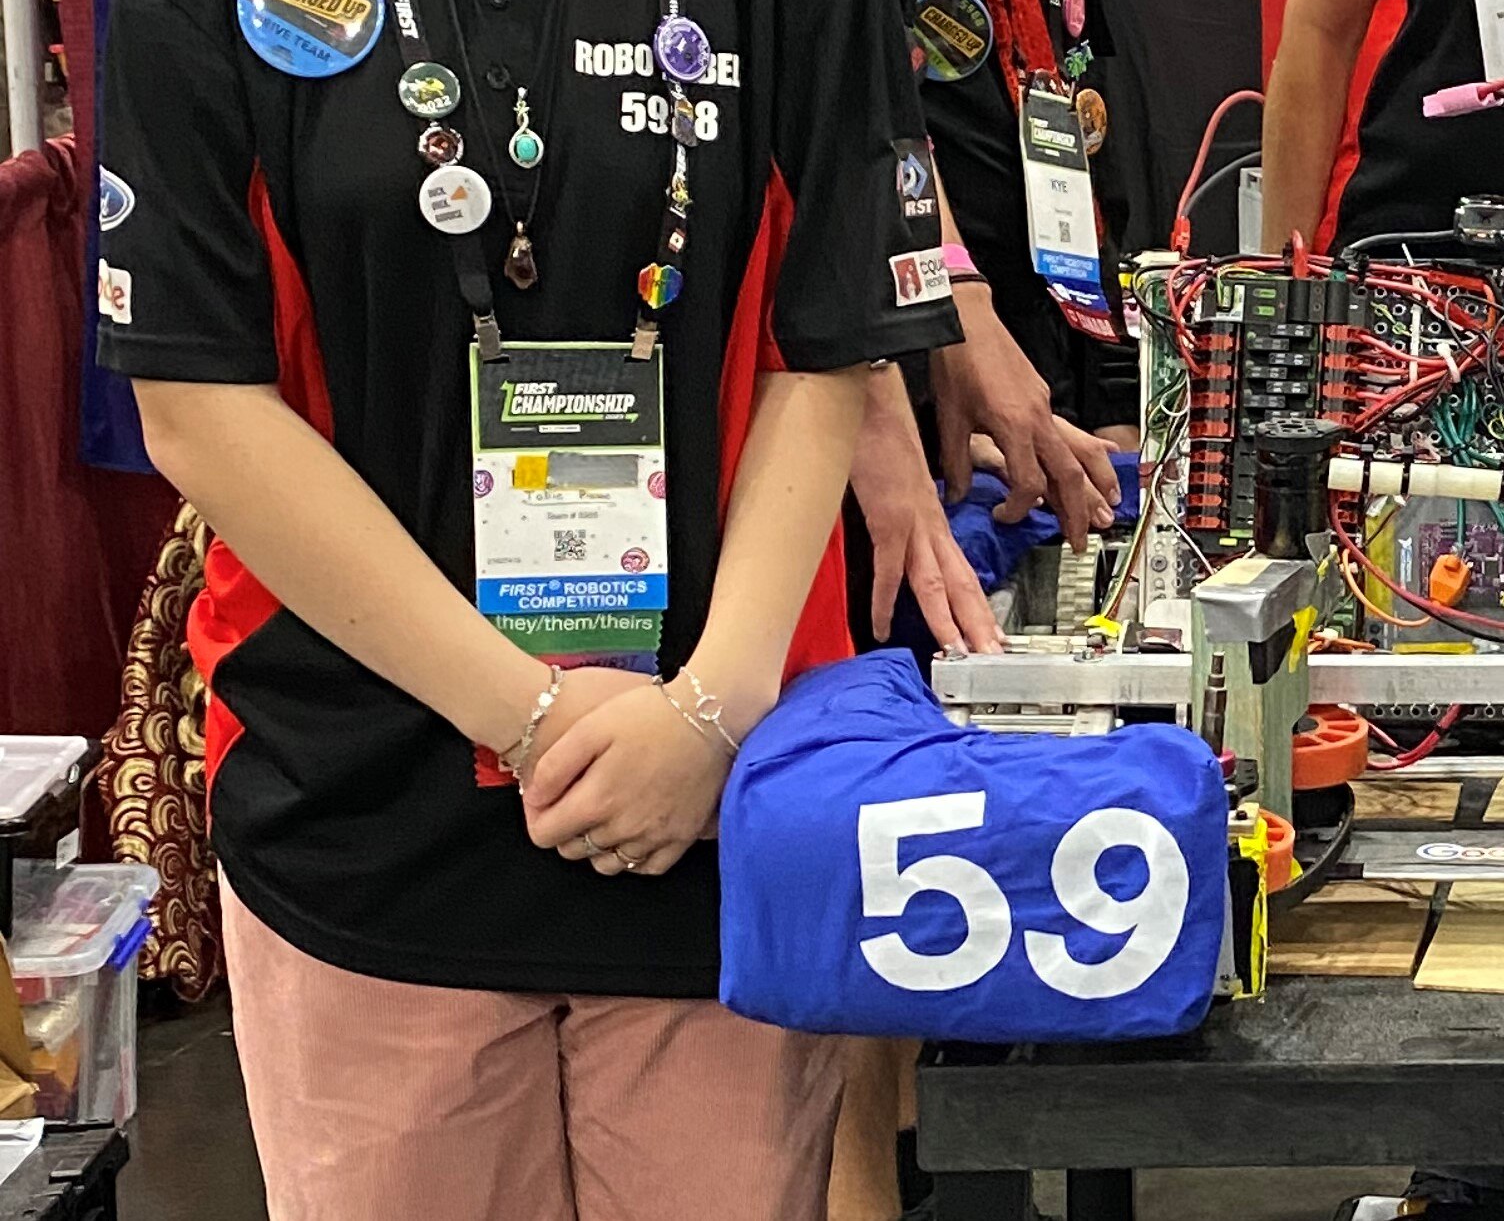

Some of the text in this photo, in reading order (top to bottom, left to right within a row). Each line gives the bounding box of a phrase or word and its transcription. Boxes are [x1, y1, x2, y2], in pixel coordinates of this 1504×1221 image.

[293, 34, 331, 62] TEAM
[620, 91, 718, 142] 598
[1050, 179, 1068, 194] KYE
[514, 382, 558, 395] FIRST
[511, 393, 636, 415] CHAMPIONSHIP
[564, 580, 648, 595] ROBOTICS
[518, 594, 630, 610] COMPETITION
[496, 612, 654, 636] they/them/theirs
[857, 790, 1191, 1000] 59
